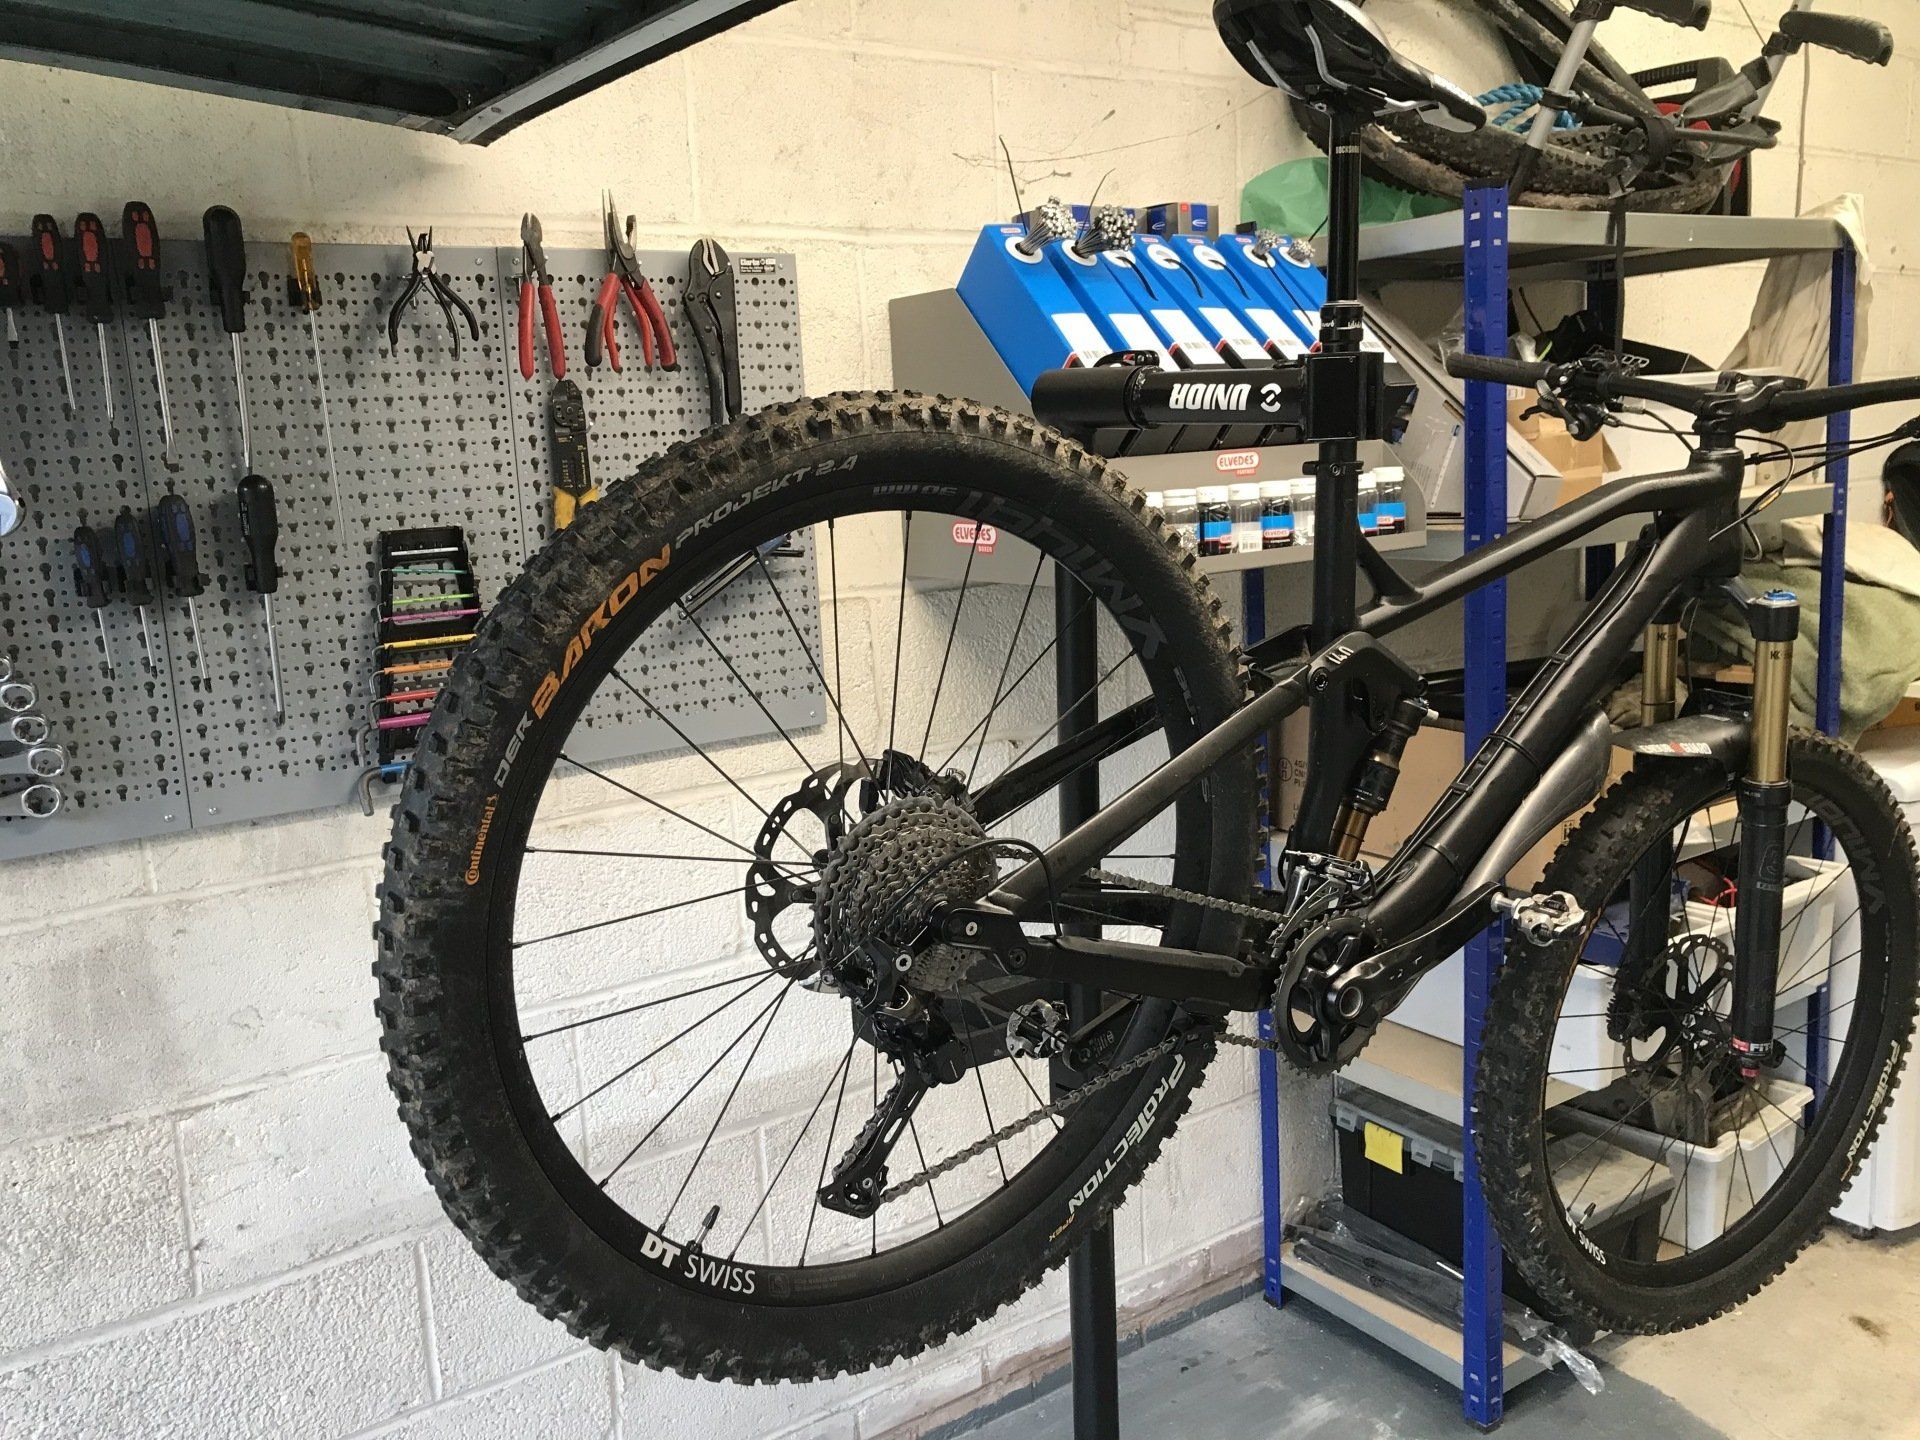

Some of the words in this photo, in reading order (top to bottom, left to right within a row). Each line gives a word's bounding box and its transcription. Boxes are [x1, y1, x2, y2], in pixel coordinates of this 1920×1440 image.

[1168, 383, 1252, 411] UNIOR
[1219, 454, 1255, 468] ELVEDES
[675, 466, 812, 550] PROJEKT
[815, 454, 858, 477] 2.4
[955, 526, 992, 541] ELVEES
[493, 710, 534, 789] DER
[531, 543, 671, 720] BARON
[1068, 1053, 1187, 1215] PROTECTION
[640, 1231, 682, 1269] DT
[683, 1253, 756, 1295] SWISS
